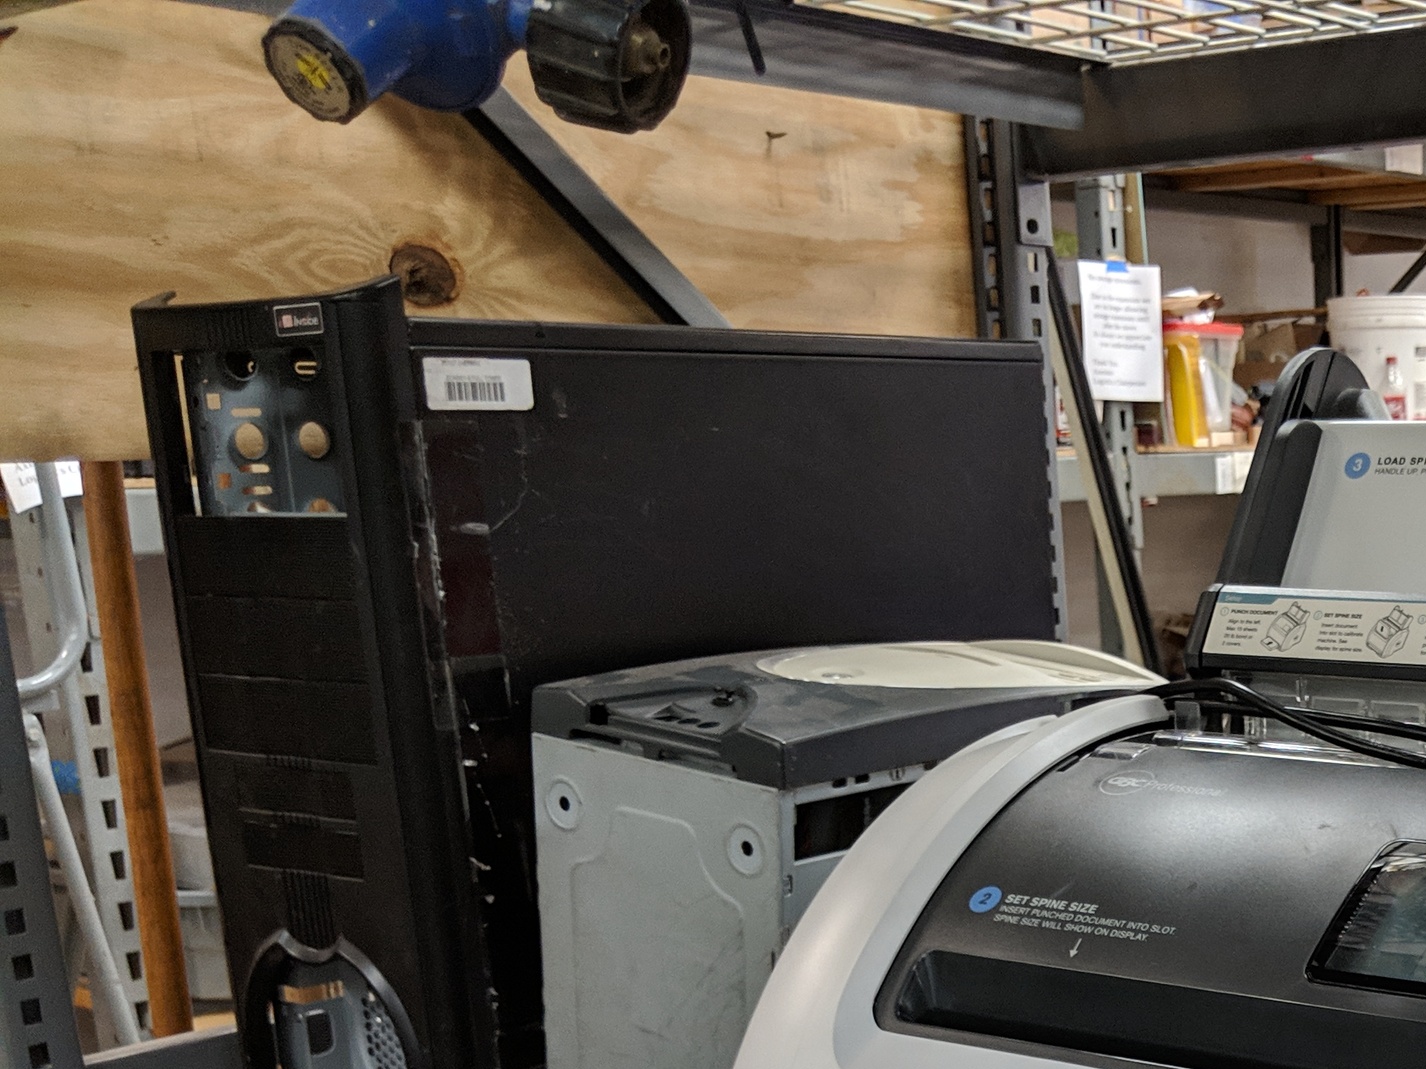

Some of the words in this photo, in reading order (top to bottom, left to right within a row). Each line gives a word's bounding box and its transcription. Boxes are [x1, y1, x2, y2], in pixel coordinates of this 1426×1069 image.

[1352, 458, 1363, 472] 3
[1377, 456, 1406, 466] LOAD
[1107, 776, 1147, 787] GBC
[1142, 780, 1222, 796] Professional
[978, 892, 992, 905] 2
[1005, 894, 1030, 904] SET
[1030, 897, 1068, 910] SPINE
[1068, 902, 1099, 914] SIZE
[993, 914, 1020, 925] SPINE
[1020, 917, 1042, 927] SIZE
[1042, 920, 1062, 930] WILL
[1064, 923, 1094, 934] SHOW
[1094, 927, 1110, 936] ON
[1110, 929, 1150, 942] DISPLAY.
[998, 904, 1031, 915] INSERT
[1030, 908, 1074, 921] PUNCHED
[1074, 914, 1126, 928] DOCUMENT
[1126, 921, 1150, 932] INTO
[1150, 924, 1176, 935] SLOT.
